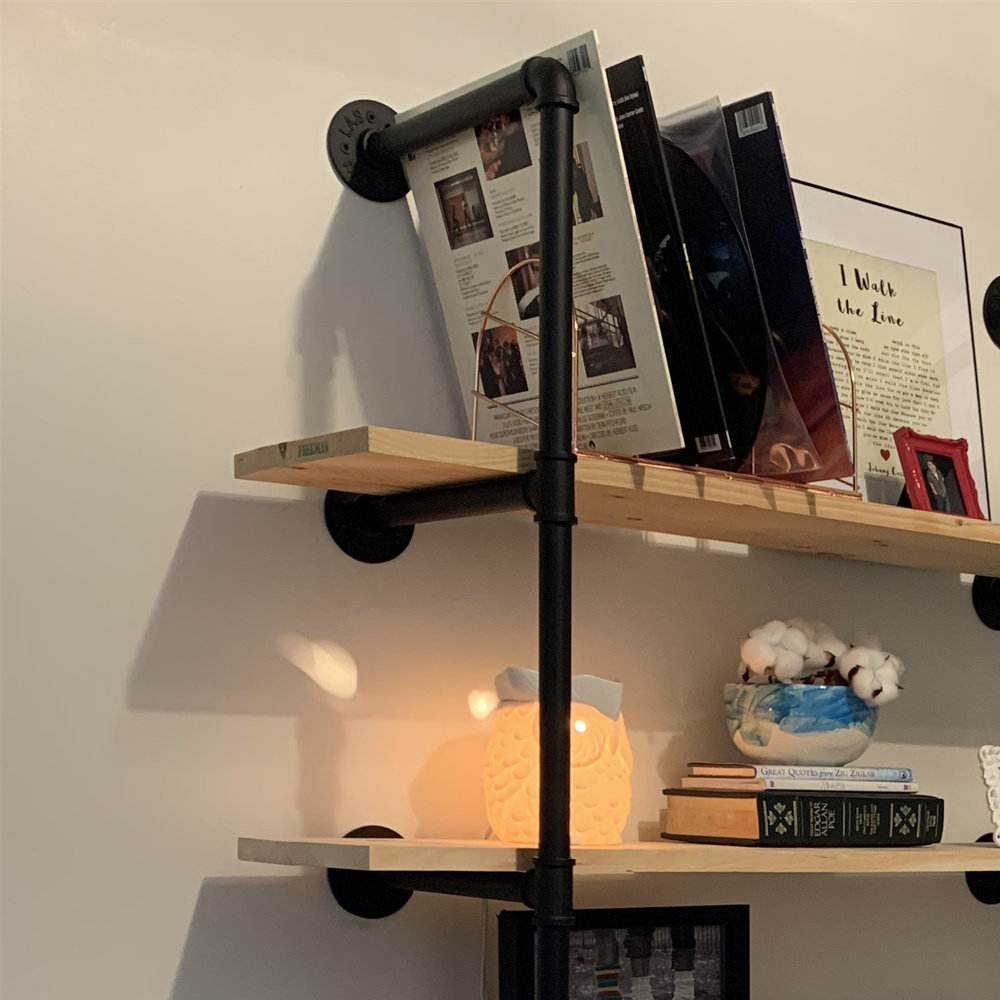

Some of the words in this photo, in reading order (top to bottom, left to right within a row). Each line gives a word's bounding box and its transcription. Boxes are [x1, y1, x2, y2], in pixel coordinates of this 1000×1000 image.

[838, 263, 848, 286] I
[854, 268, 896, 298] Walk
[837, 297, 864, 317] the
[871, 301, 904, 327] Line
[761, 767, 786, 776] GREAT
[788, 768, 818, 777] QUOTES
[835, 769, 848, 778] ZIG
